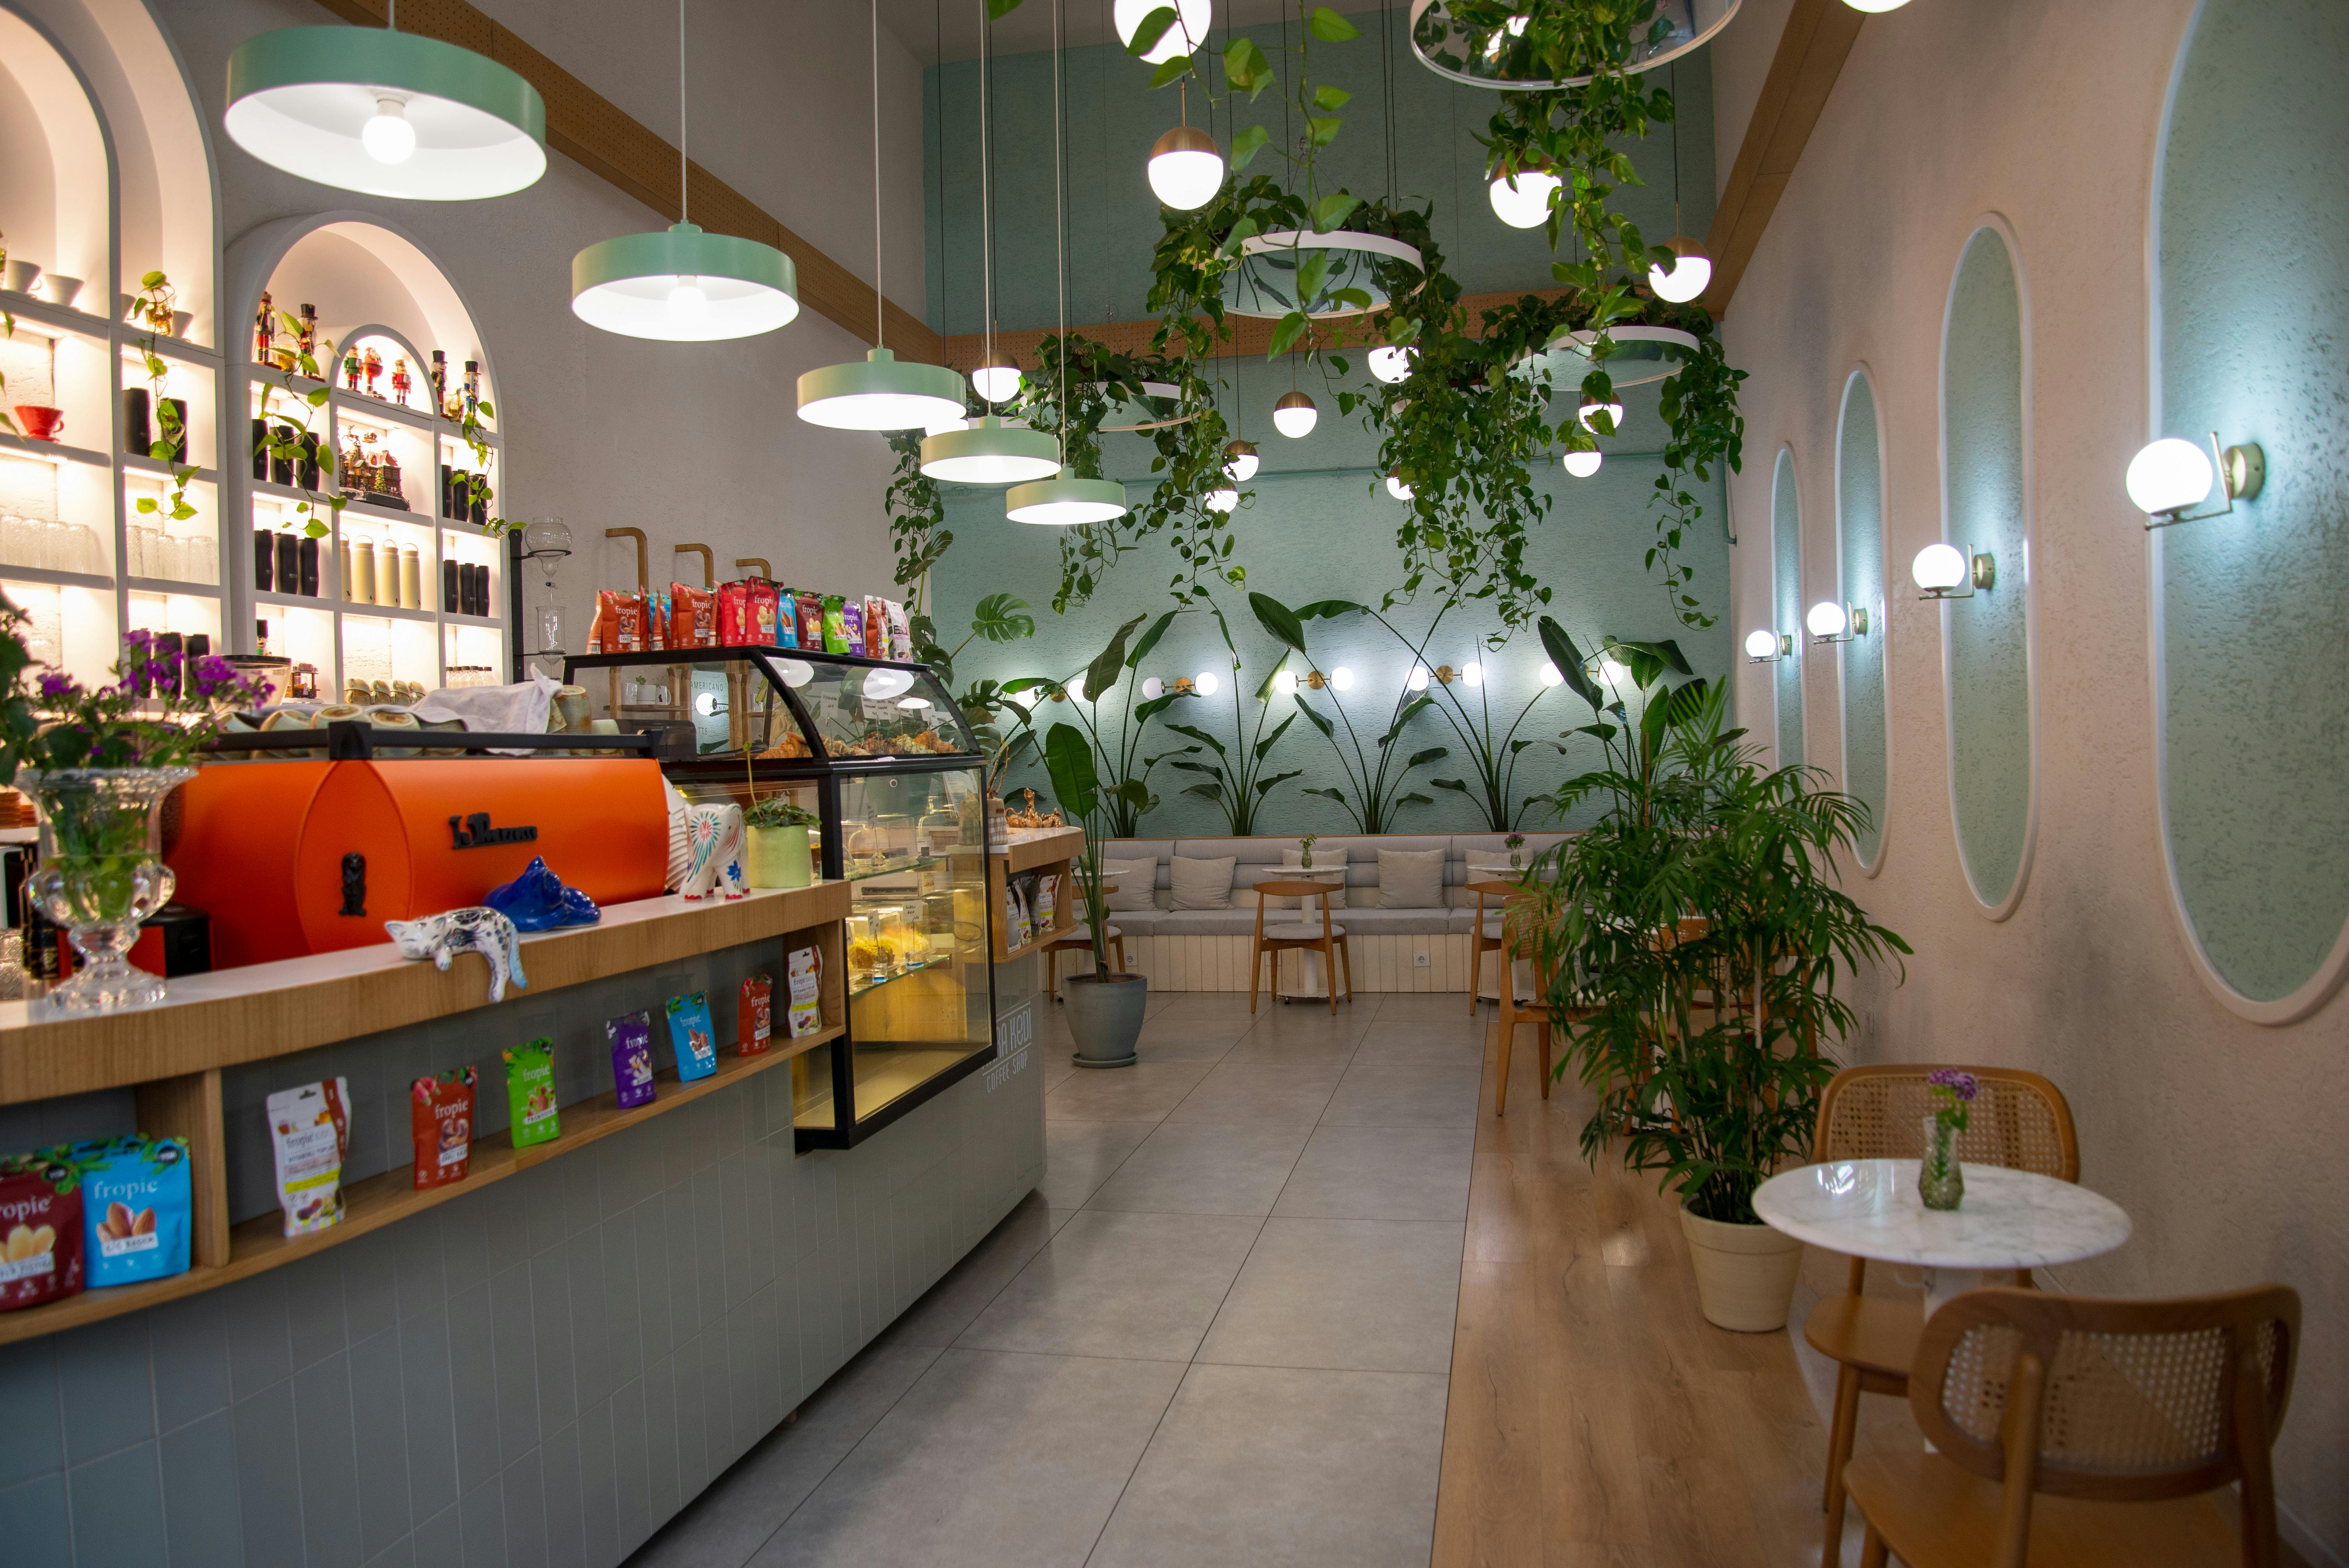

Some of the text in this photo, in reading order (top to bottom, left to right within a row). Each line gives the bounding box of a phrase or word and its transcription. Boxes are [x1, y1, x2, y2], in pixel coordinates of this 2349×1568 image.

[615, 606, 638, 617] fropie
[692, 599, 711, 611] fropie
[802, 605, 818, 616] fropie
[691, 681, 723, 691] AMERICANO
[751, 993, 770, 1007] fropie
[626, 1033, 648, 1049] fropie
[523, 1064, 551, 1082] fropie
[987, 1050, 1028, 1093] COFFEE SHOP
[435, 1099, 469, 1119] fropie
[94, 1177, 158, 1200] fropie
[0, 1195, 51, 1222] opie
